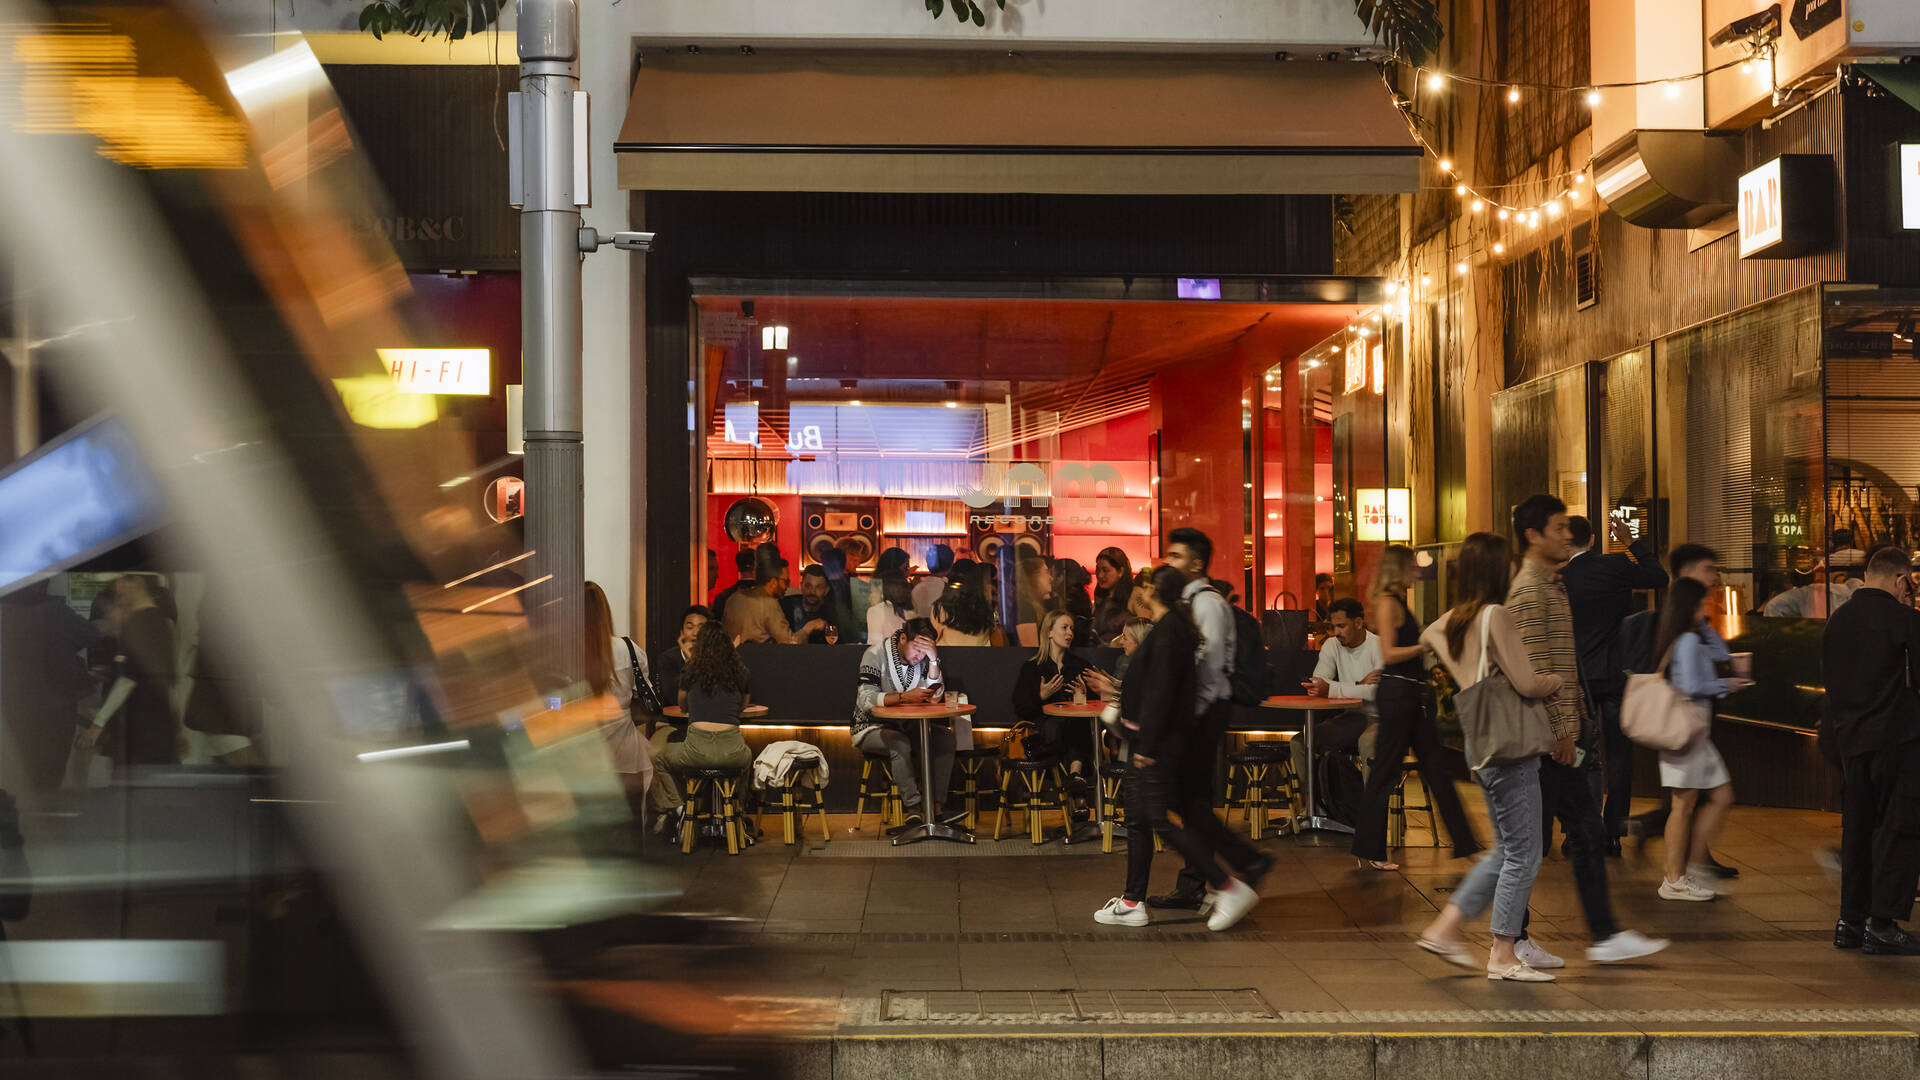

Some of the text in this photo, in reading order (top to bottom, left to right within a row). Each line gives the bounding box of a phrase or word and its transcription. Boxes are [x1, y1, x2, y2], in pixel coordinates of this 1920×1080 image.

[1744, 177, 1777, 239] BAR
[391, 360, 463, 383] HI-FI
[1069, 516, 1112, 525] BAR
[1773, 513, 1797, 524] BAR
[1774, 525, 1803, 536] TOPA
